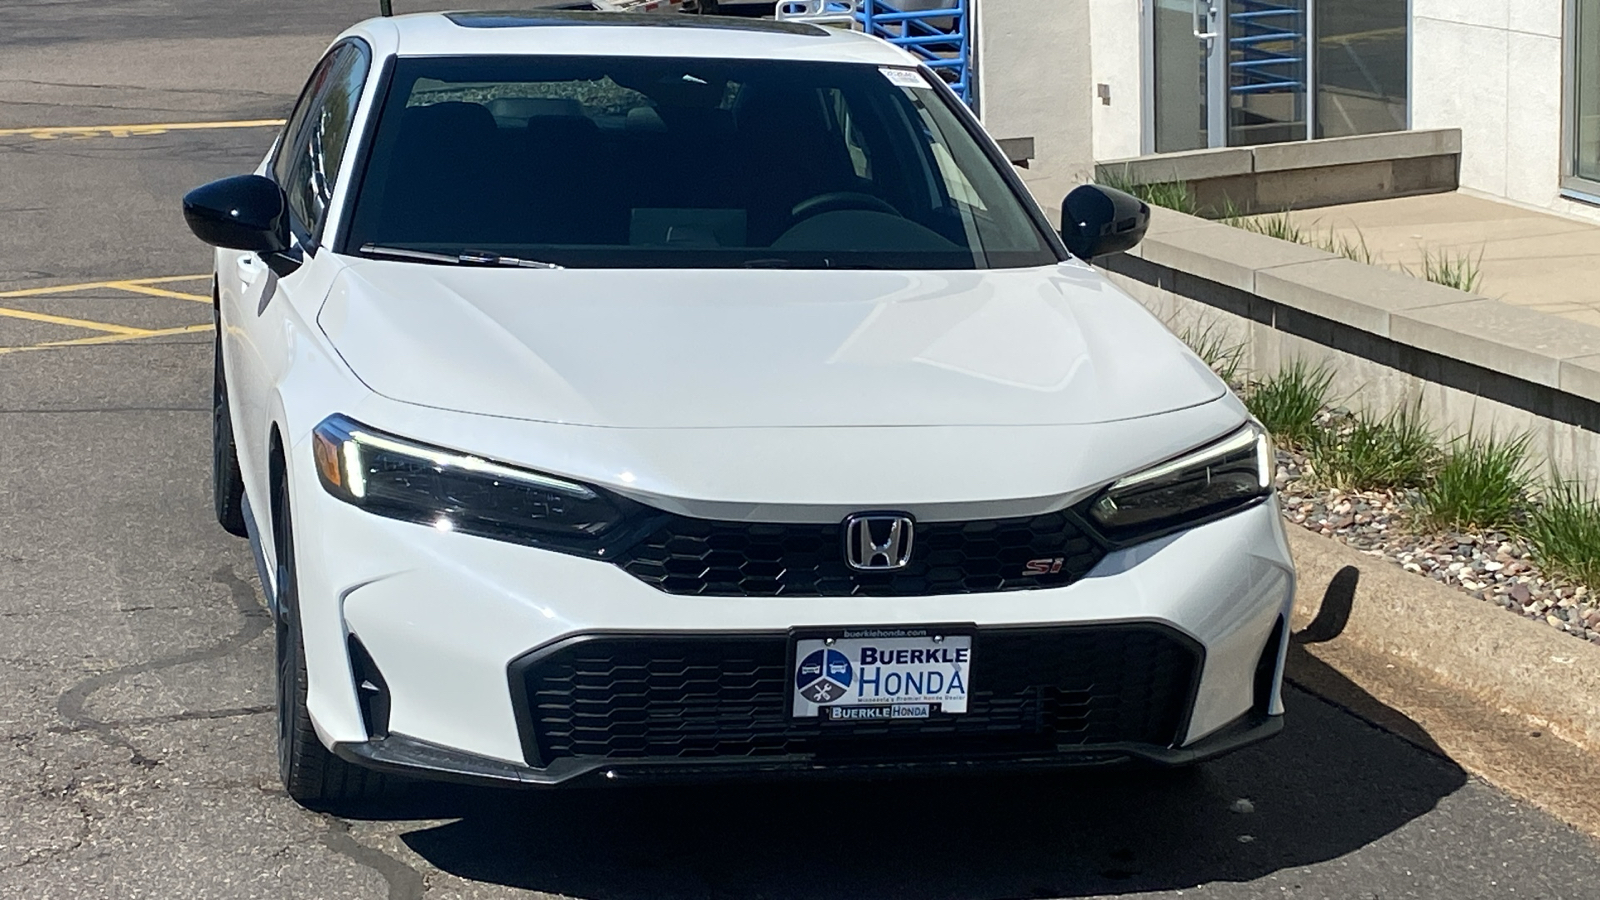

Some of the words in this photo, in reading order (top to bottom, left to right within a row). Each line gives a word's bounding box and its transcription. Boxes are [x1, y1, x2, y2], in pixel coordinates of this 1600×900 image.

[1022, 558, 1064, 576] Si
[844, 628, 927, 638] buerklehonda.com
[860, 647, 968, 665] BUERKLE
[858, 667, 965, 697] HONDA
[832, 707, 891, 718] BUERKLE
[892, 706, 927, 717] HONDA
